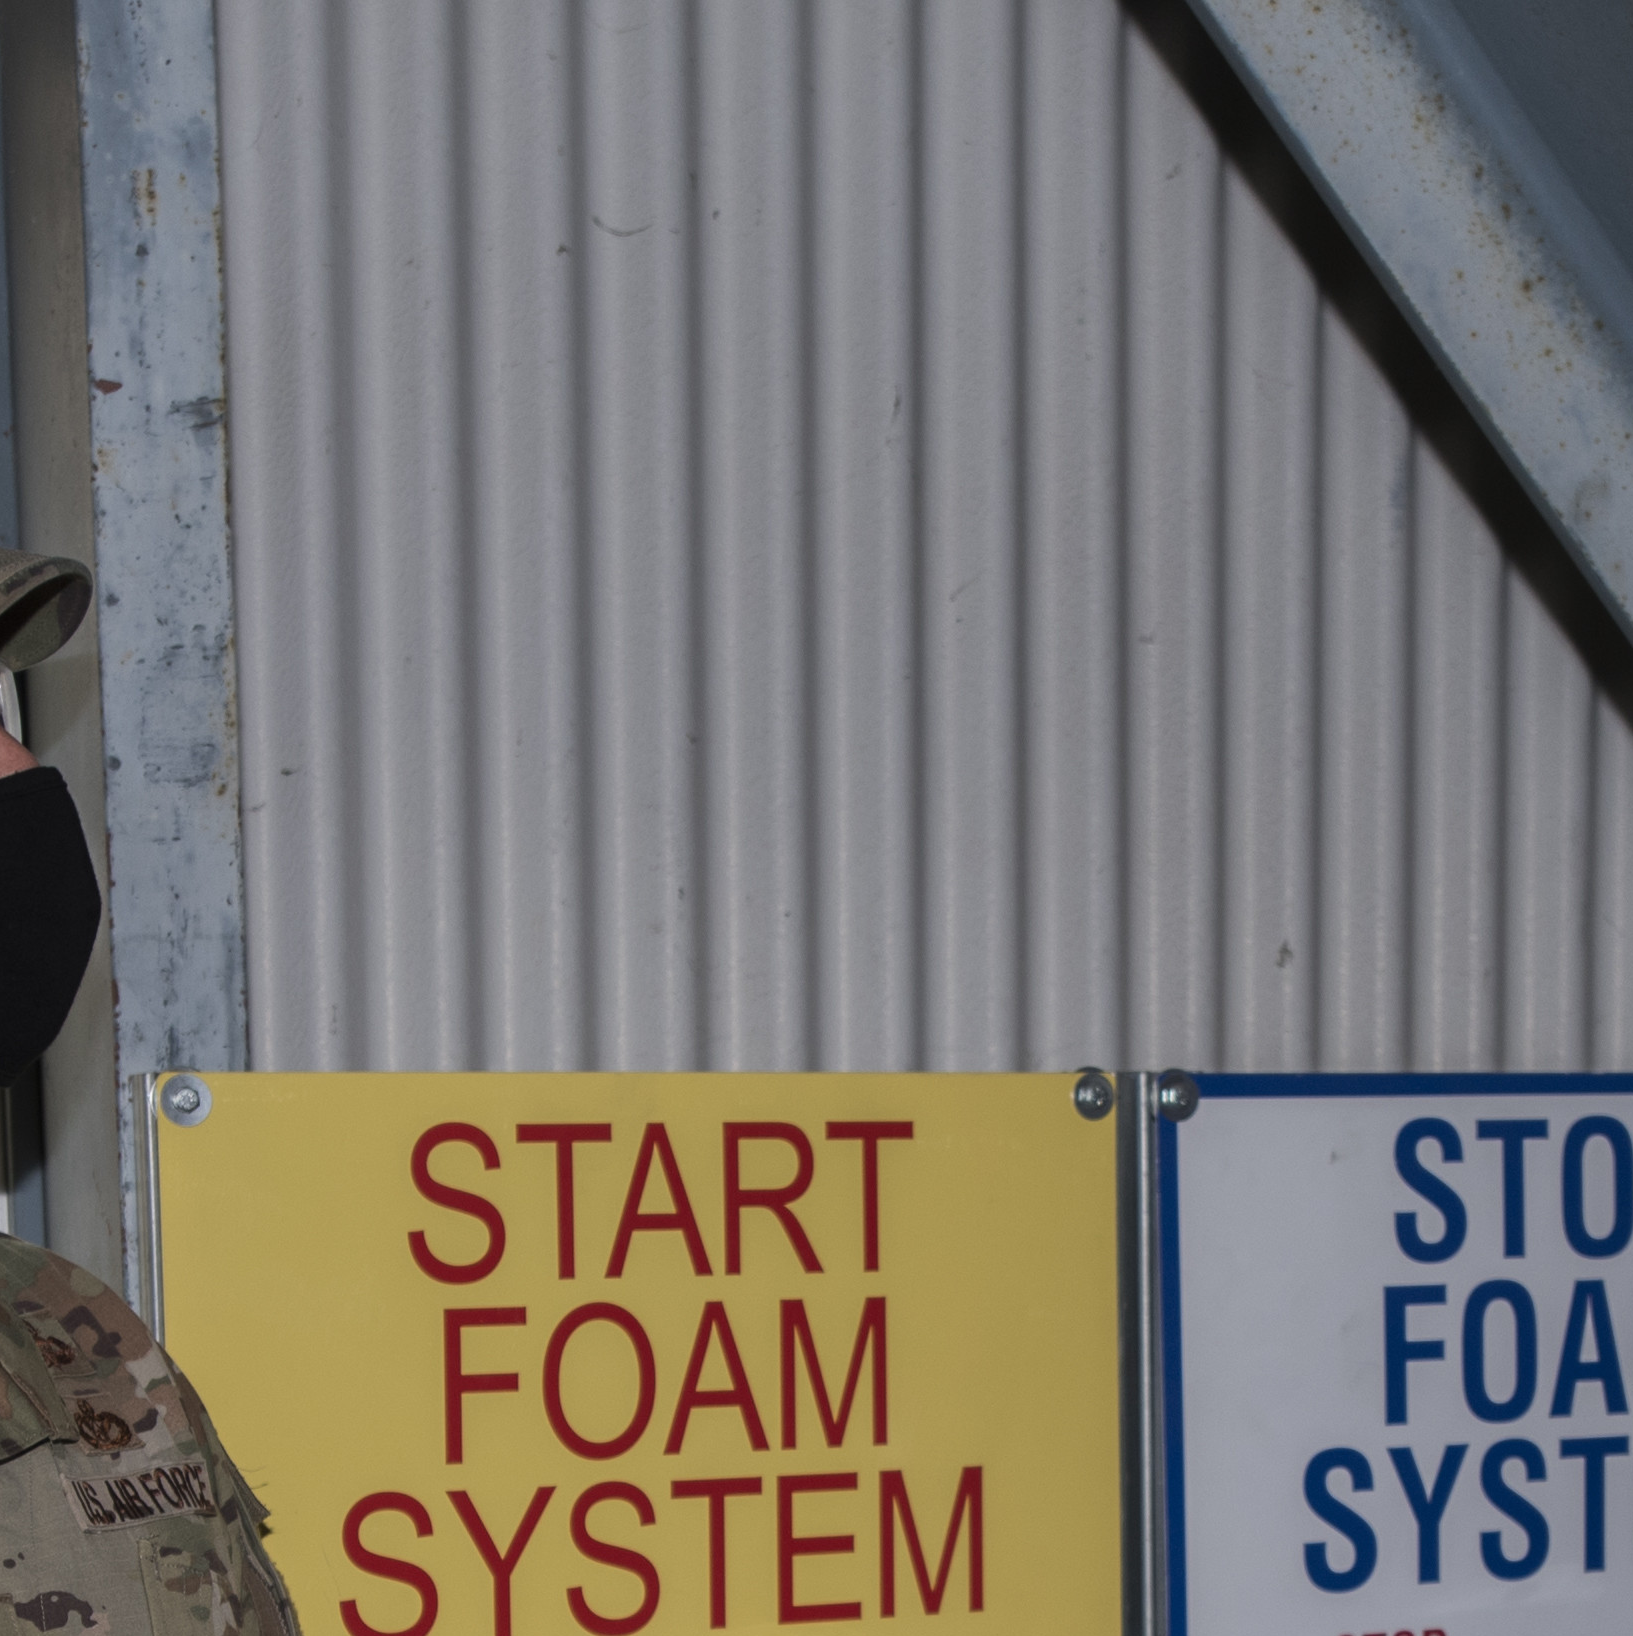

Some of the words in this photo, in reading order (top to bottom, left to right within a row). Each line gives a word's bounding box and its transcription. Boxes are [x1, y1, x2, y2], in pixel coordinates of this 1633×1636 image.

[408, 1120, 915, 1284] START
[443, 1296, 889, 1465] FOAM
[104, 1477, 155, 1522] AIR
[138, 1463, 213, 1514] FORCE
